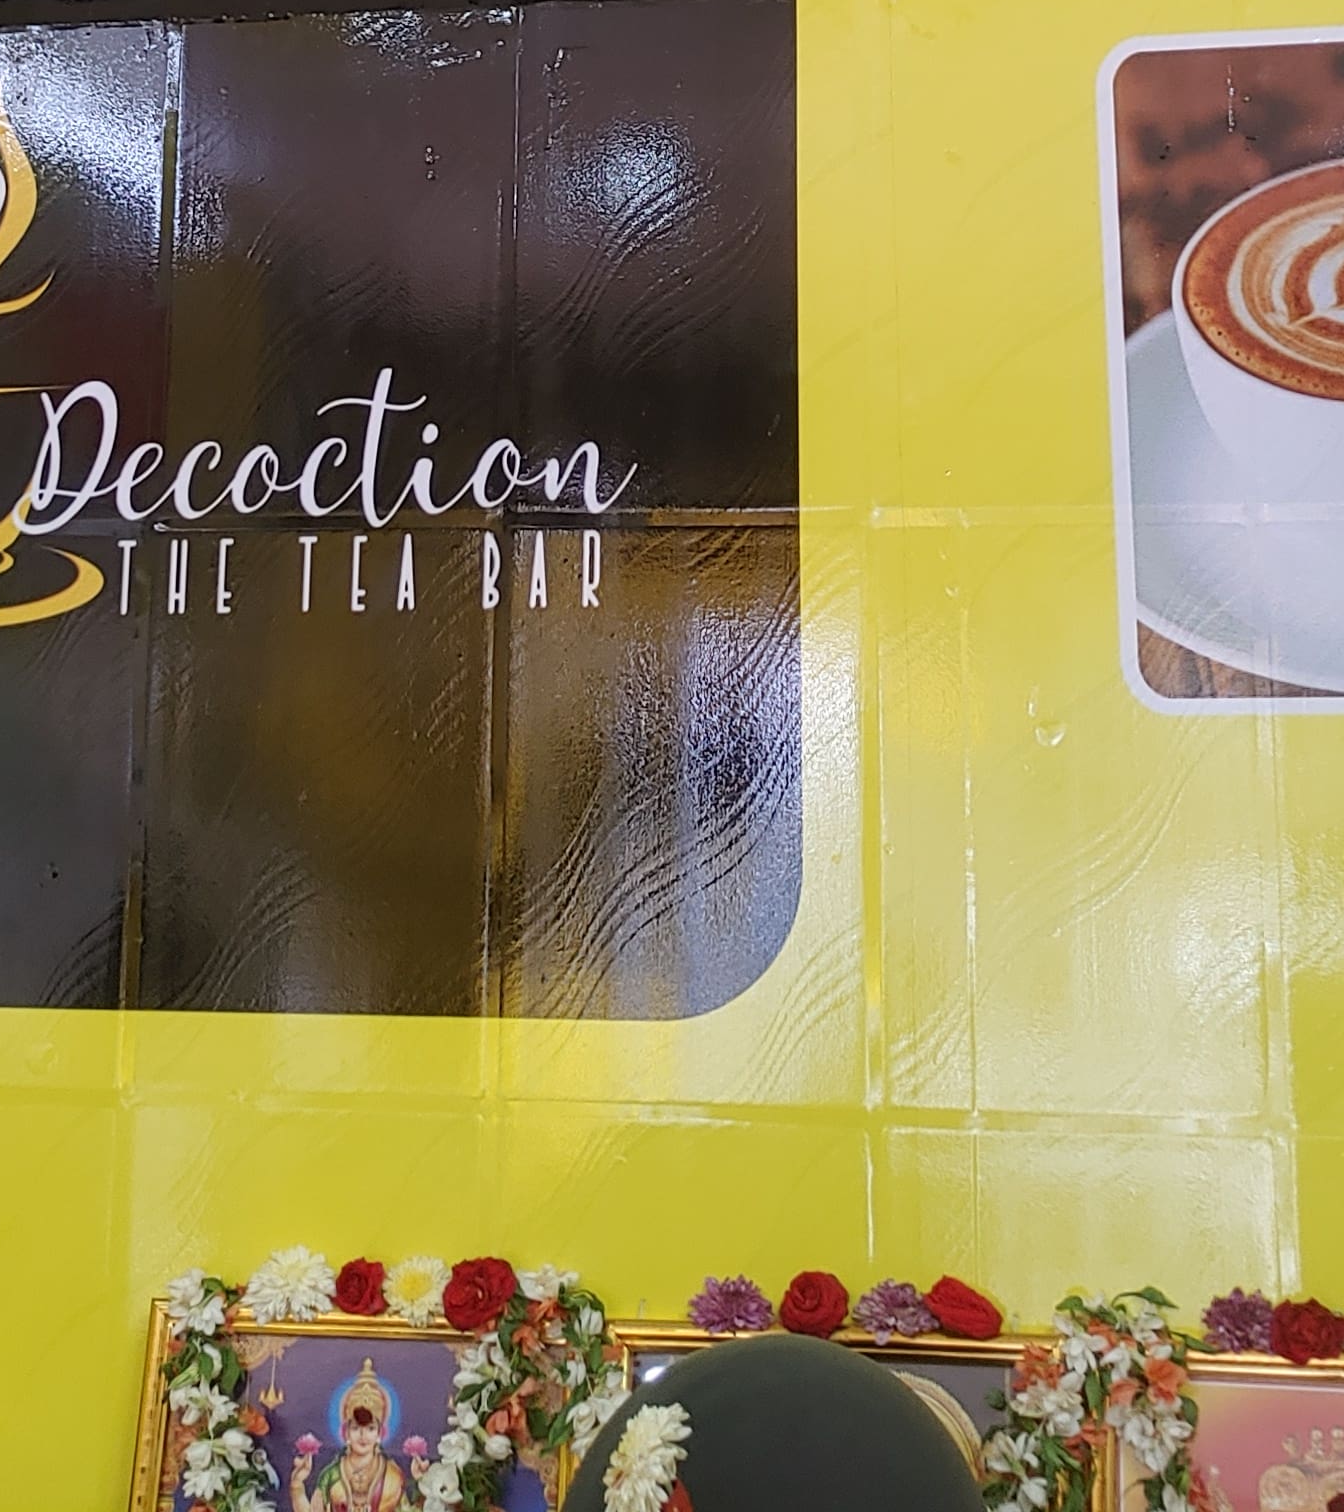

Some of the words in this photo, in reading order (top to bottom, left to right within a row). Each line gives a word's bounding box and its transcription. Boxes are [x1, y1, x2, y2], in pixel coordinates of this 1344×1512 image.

[12, 366, 635, 540] Decoction
[118, 539, 234, 615] THE
[299, 534, 414, 612] TEA
[483, 530, 600, 609] BAR
